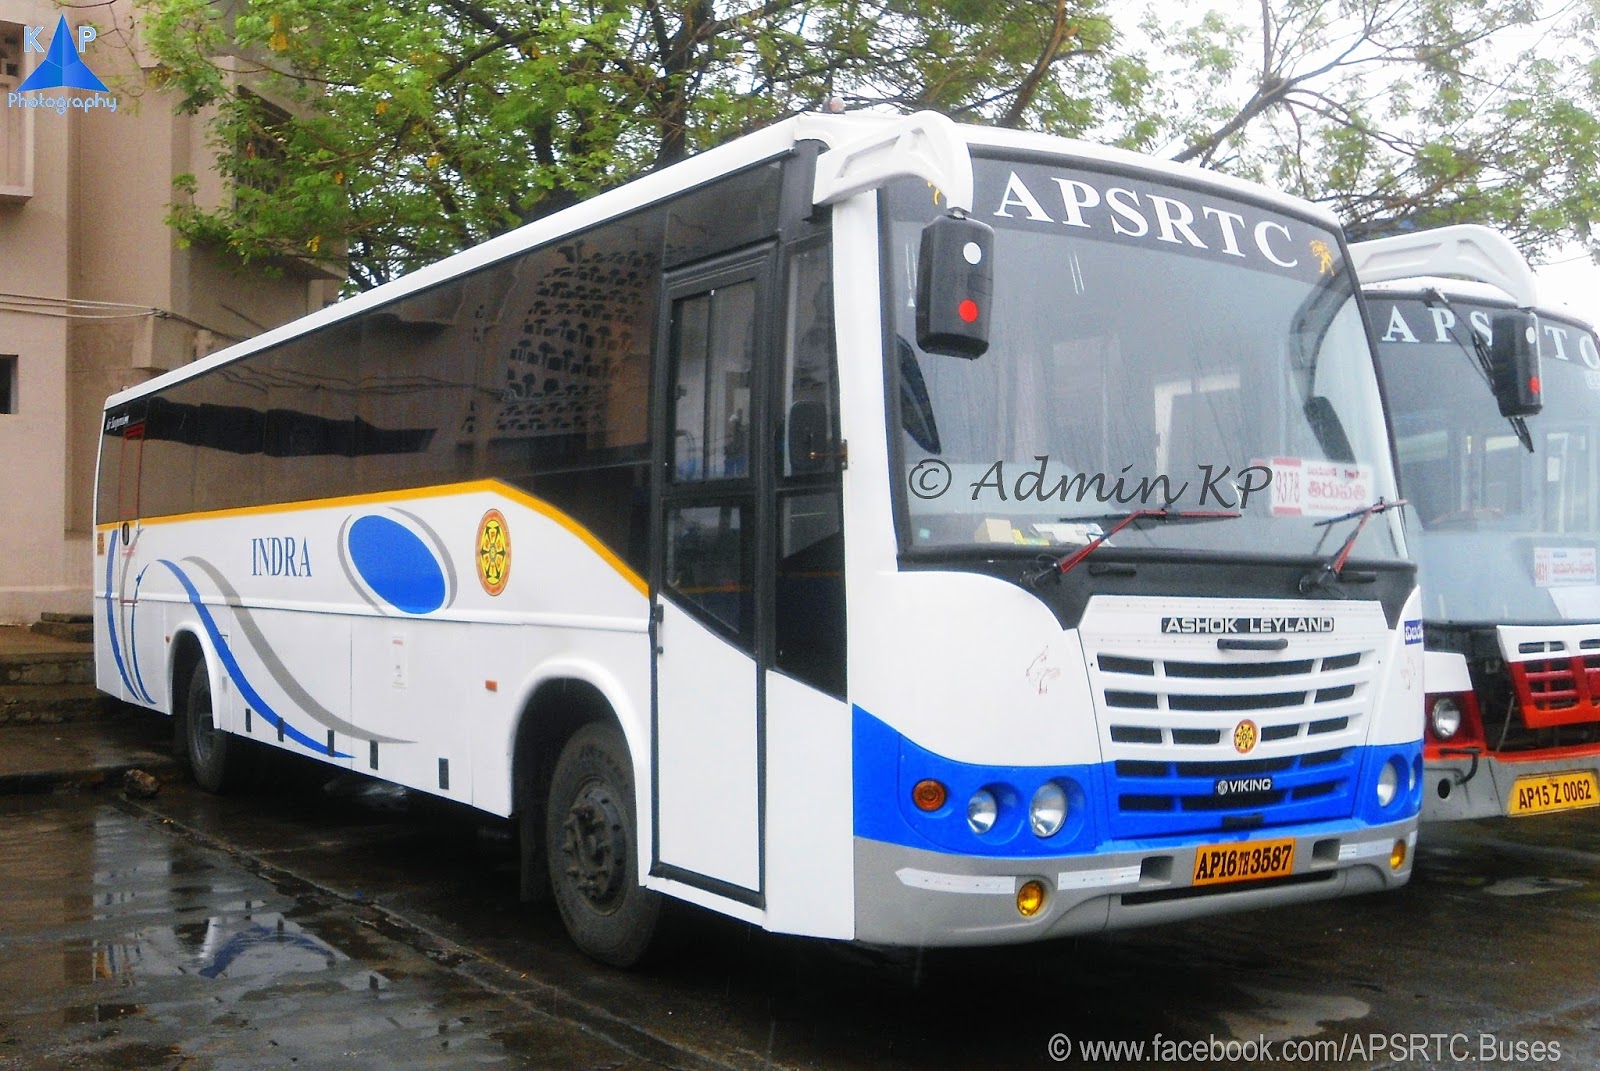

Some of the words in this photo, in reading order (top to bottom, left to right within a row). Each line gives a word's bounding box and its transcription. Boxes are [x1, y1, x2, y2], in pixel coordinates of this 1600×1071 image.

[993, 170, 1299, 268] APSRTC
[252, 536, 312, 577] INDRA
[1166, 617, 1238, 633] ASHOK
[1250, 617, 1335, 633] LEYLAND
[1229, 778, 1271, 793] VIKING
